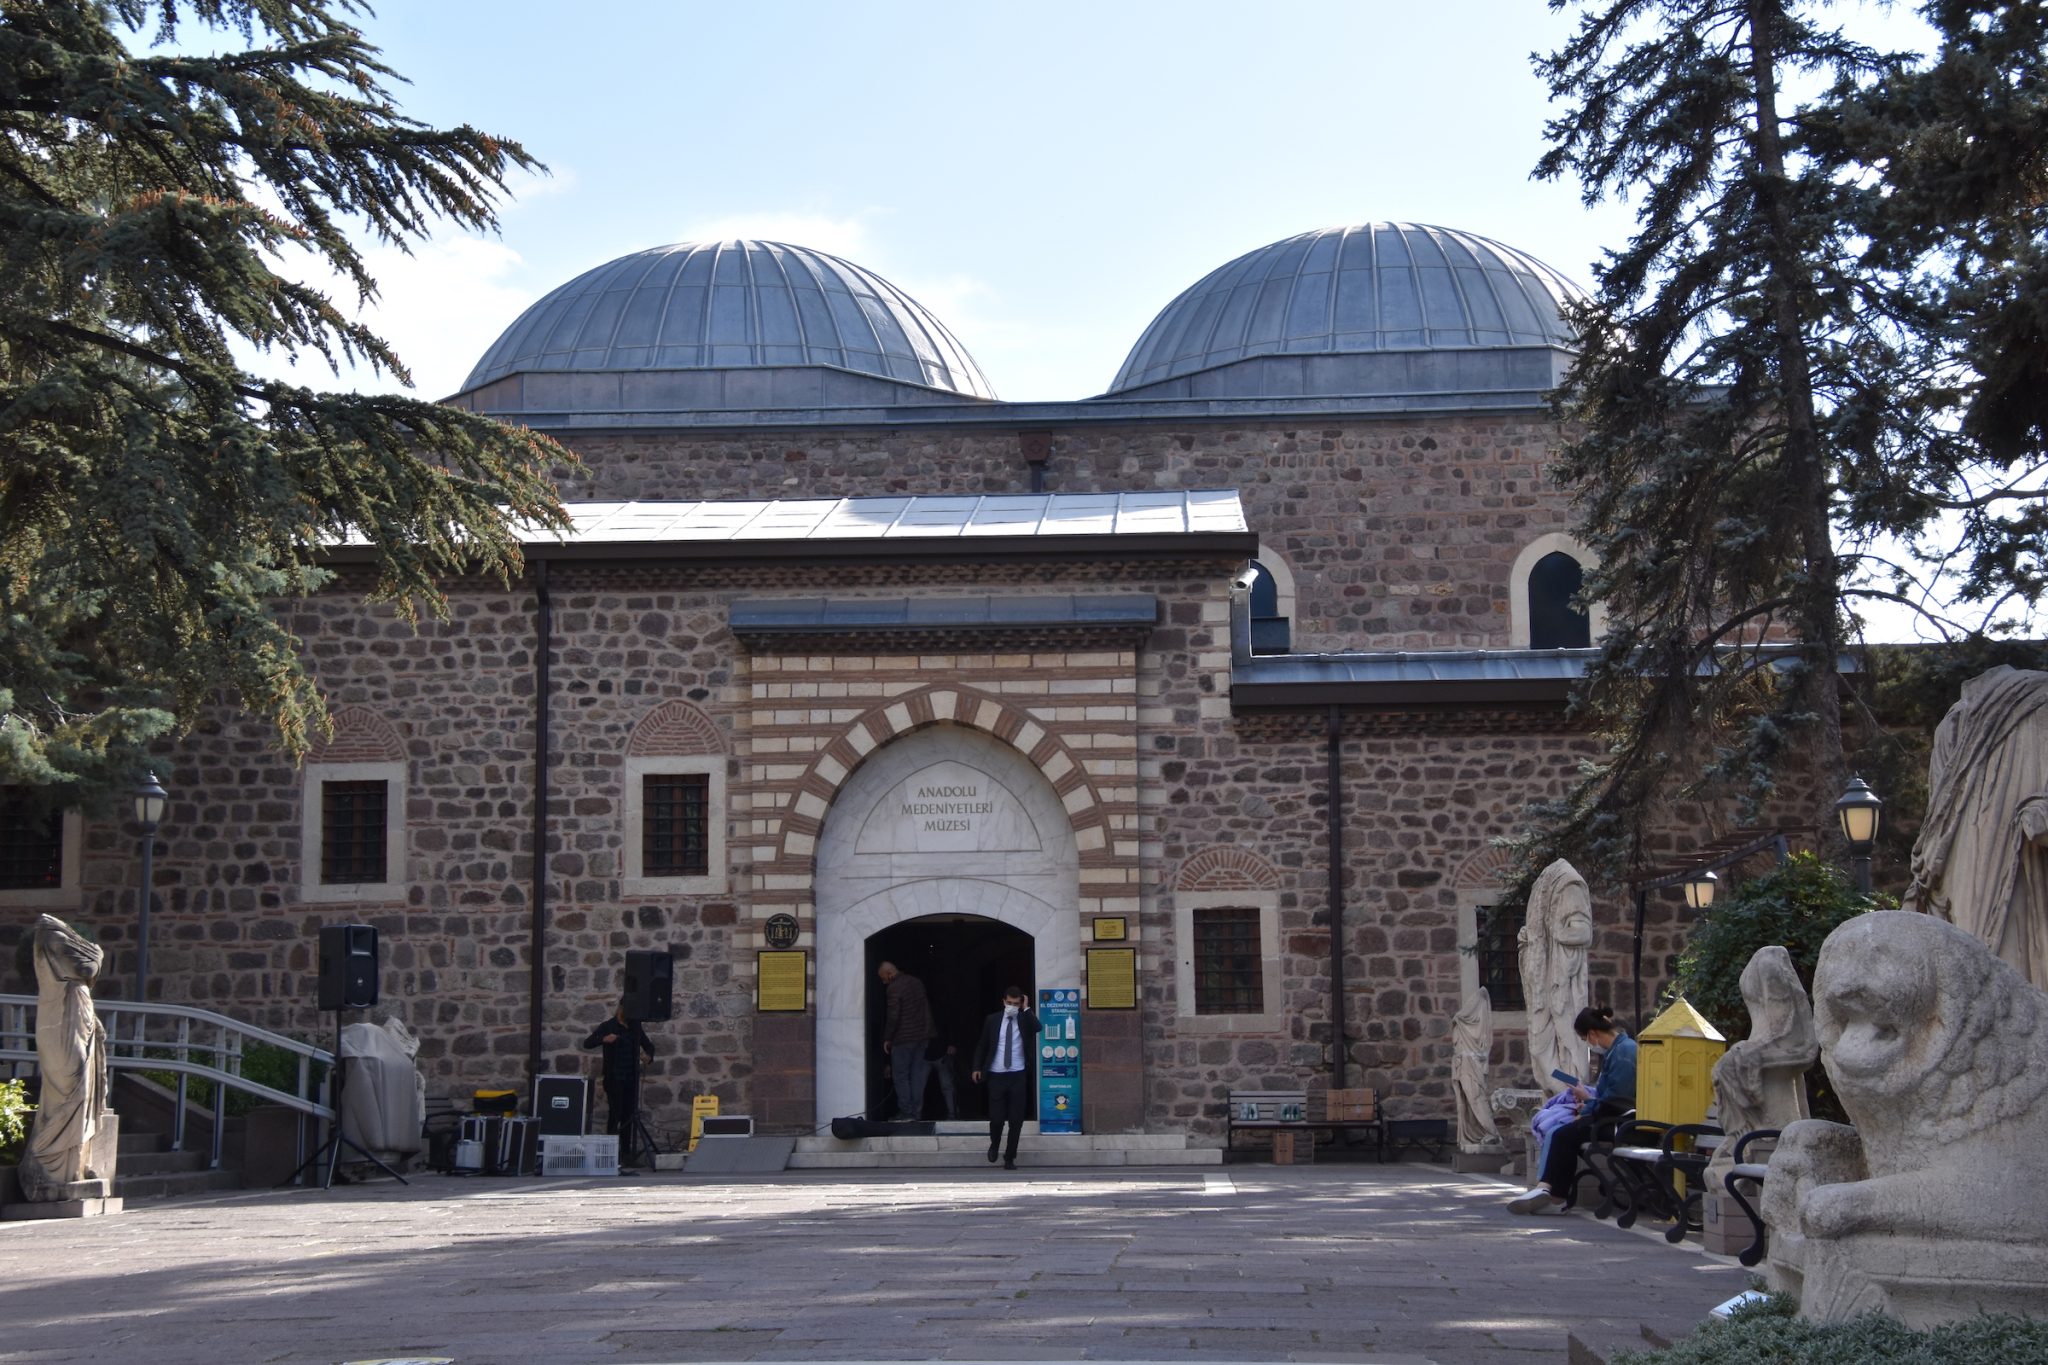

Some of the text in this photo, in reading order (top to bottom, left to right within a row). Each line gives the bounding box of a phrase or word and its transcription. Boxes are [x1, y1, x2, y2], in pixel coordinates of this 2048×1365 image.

[917, 786, 977, 798] ANADOLU
[901, 801, 993, 816] MEDENİYETLERİ
[924, 818, 970, 832] MÜZESİ
